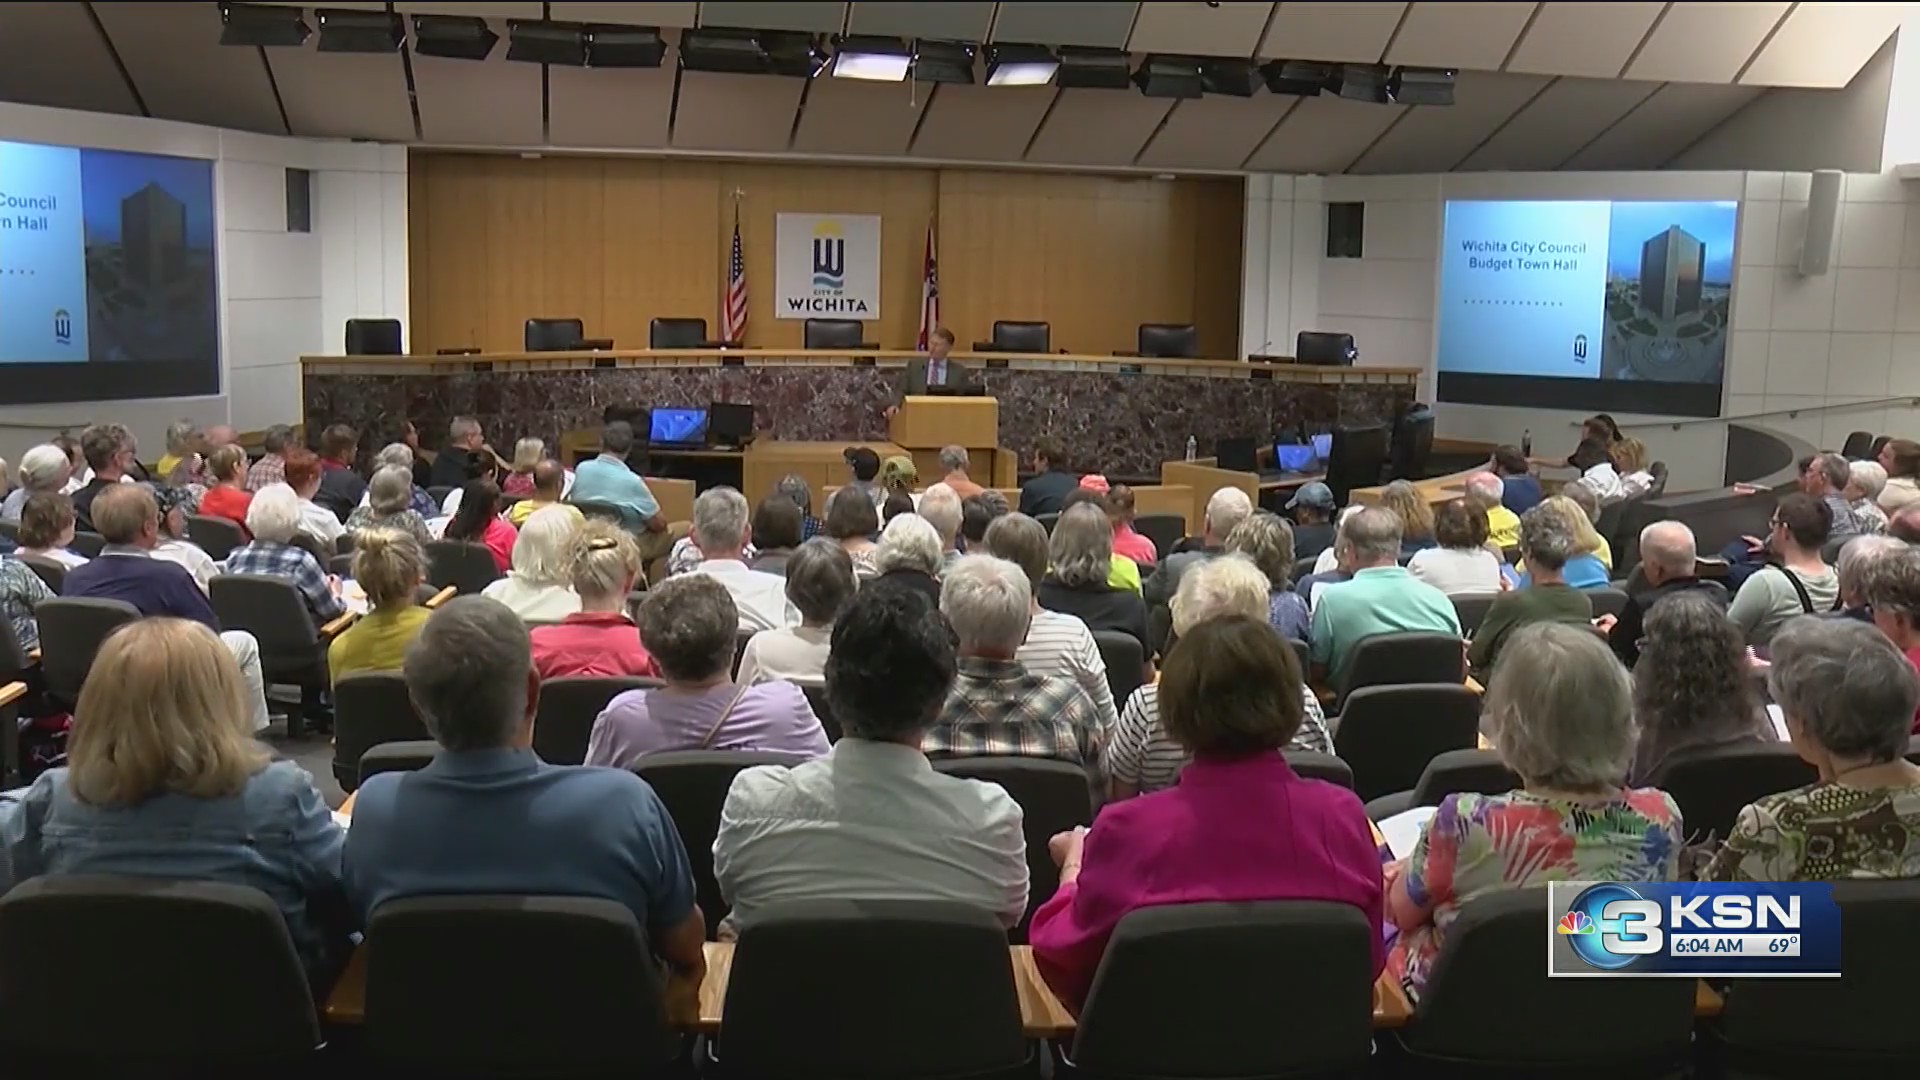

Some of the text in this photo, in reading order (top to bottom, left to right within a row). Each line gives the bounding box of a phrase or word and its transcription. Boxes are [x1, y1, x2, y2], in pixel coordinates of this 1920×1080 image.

[17, 215, 48, 231] Hall
[1462, 240, 1587, 255] Wichita City Council
[1469, 256, 1578, 272] Budget Town Hall
[788, 298, 867, 312] WICHITA
